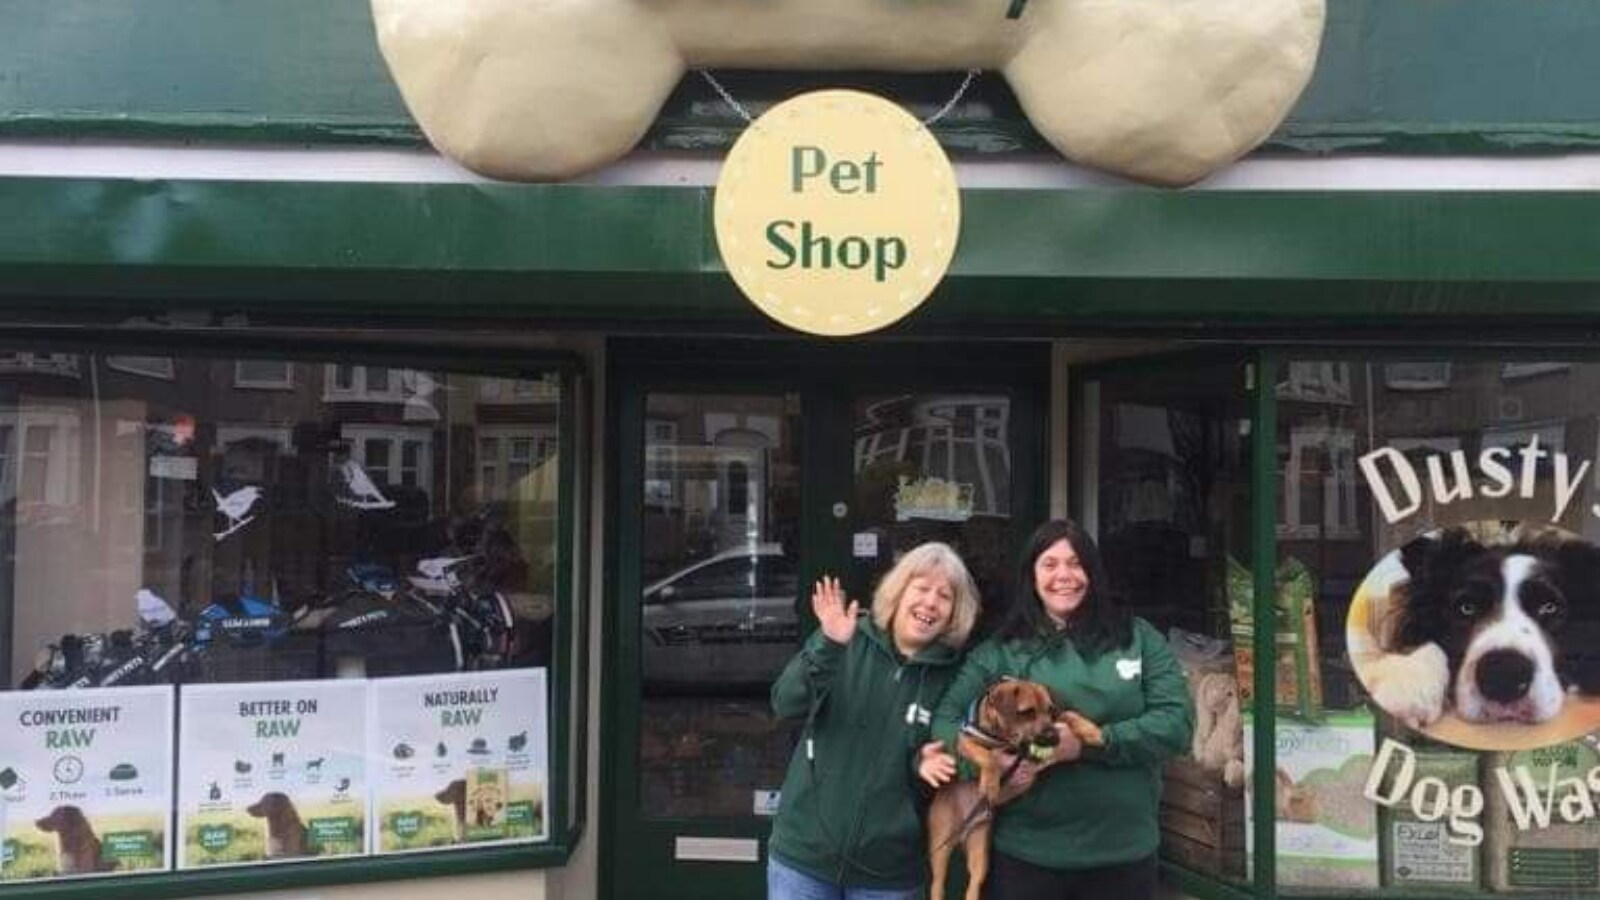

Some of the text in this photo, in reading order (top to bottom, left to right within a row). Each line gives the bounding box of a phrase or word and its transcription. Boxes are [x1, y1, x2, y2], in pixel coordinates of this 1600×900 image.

[792, 146, 883, 194] Pet
[766, 220, 906, 282] Shop
[424, 687, 498, 707] NATURALLY
[19, 706, 121, 726] CONVENIENT
[239, 699, 317, 717] BETTER ON
[256, 719, 300, 738] RAW
[441, 709, 482, 728] RAW
[45, 729, 95, 748] RAW
[1364, 738, 1484, 846] Dog
